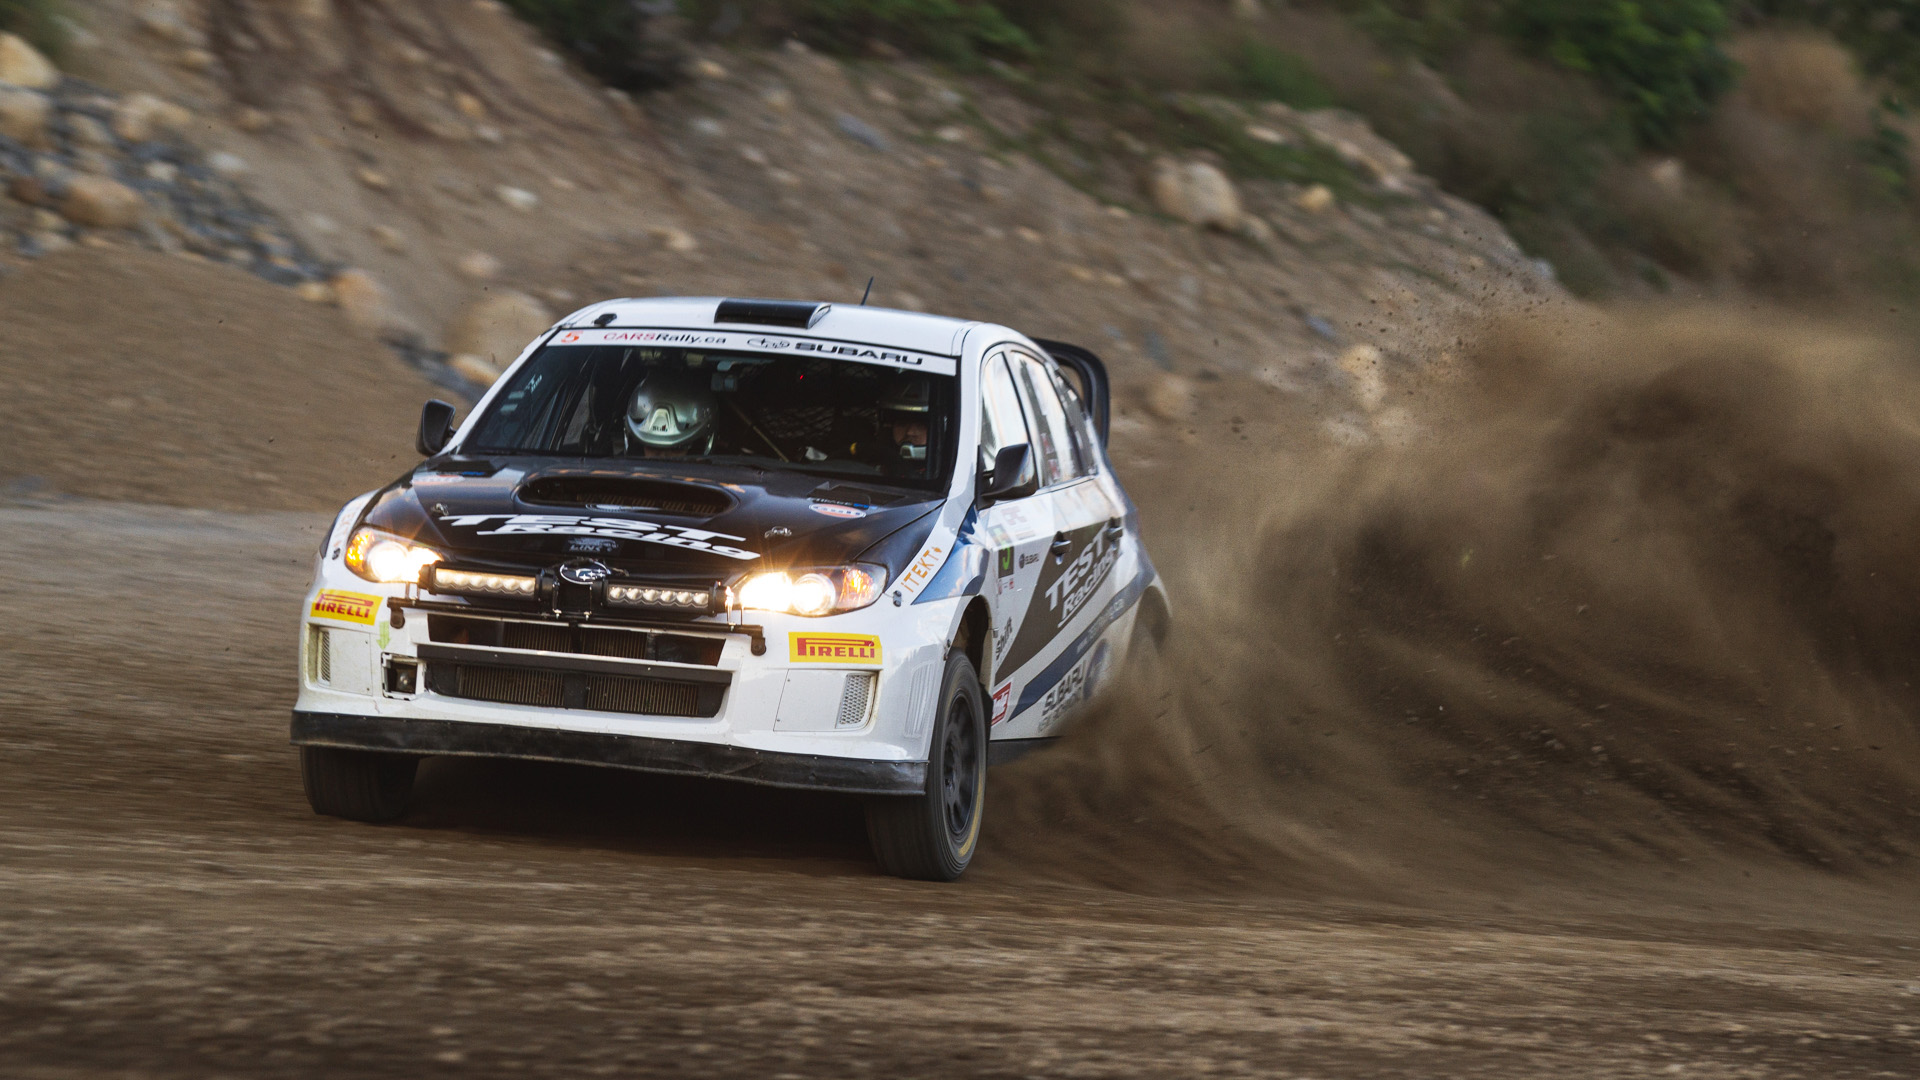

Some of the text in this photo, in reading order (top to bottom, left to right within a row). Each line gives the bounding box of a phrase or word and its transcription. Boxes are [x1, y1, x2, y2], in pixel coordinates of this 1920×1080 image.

[561, 330, 584, 344] 5
[603, 331, 727, 345] CARSRally.ca
[795, 341, 923, 366] SUBARU
[439, 513, 747, 542] TEST
[476, 523, 761, 560] Racing
[1045, 520, 1109, 612] TEST
[1057, 548, 1118, 629] Racing
[314, 593, 374, 619] PIRELLI
[797, 637, 875, 659] PIRELLI
